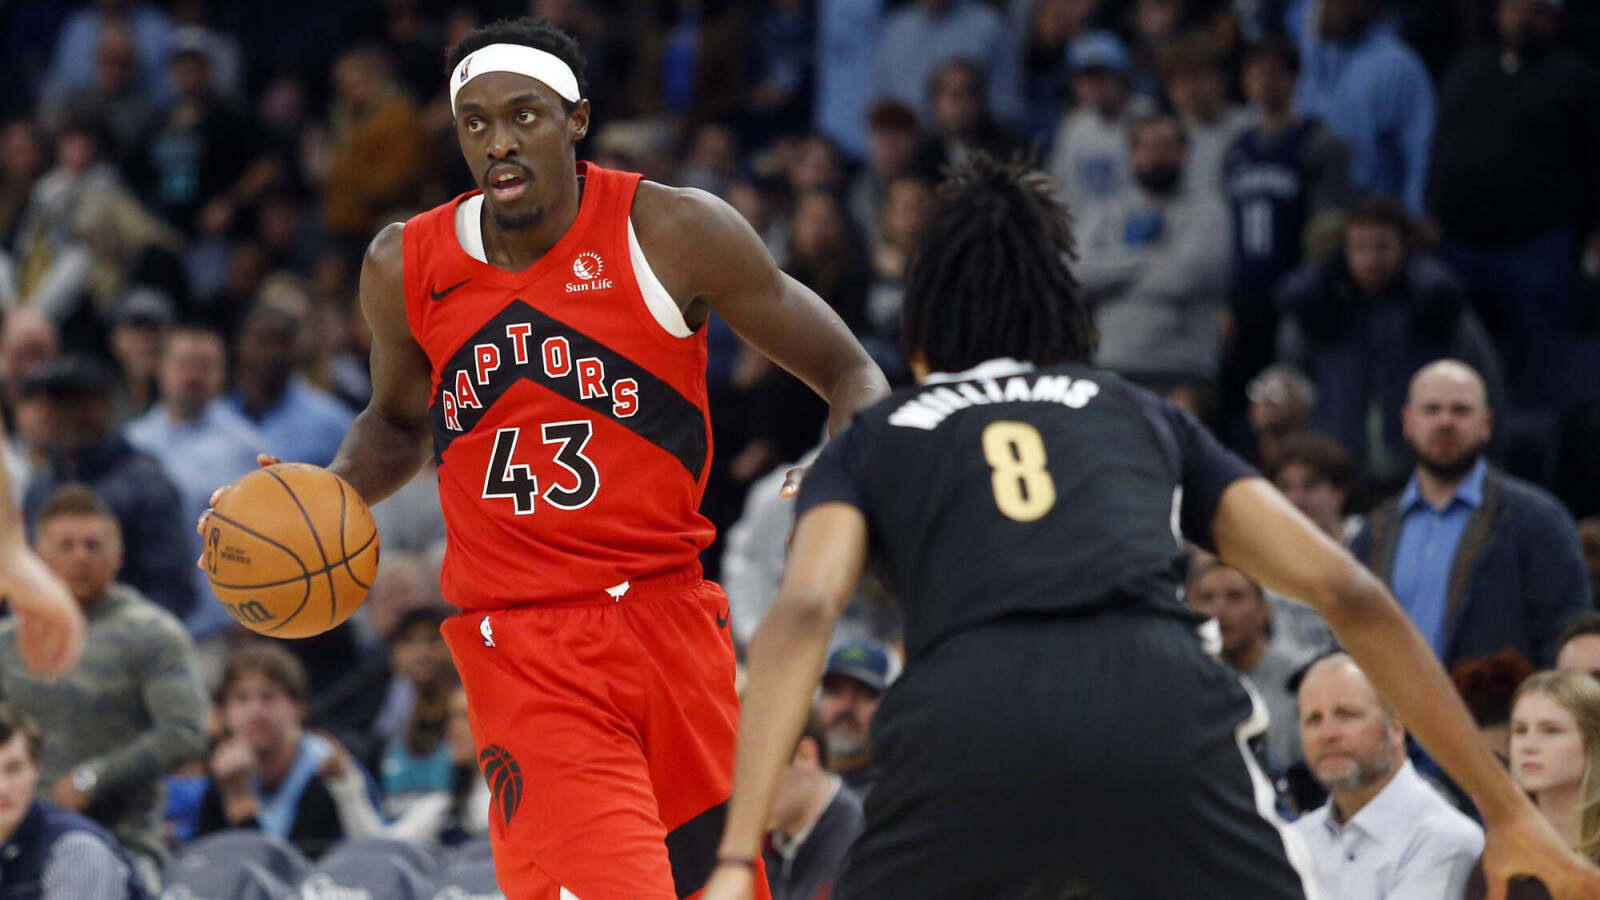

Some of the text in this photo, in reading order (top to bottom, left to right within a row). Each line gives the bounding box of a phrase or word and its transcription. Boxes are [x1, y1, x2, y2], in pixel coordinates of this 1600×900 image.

[566, 278, 613, 293] Sun Life
[443, 322, 639, 431] RAPTORS
[888, 375, 1099, 430] WILLIAMS
[481, 420, 600, 515] 43
[982, 420, 1056, 522] 8
